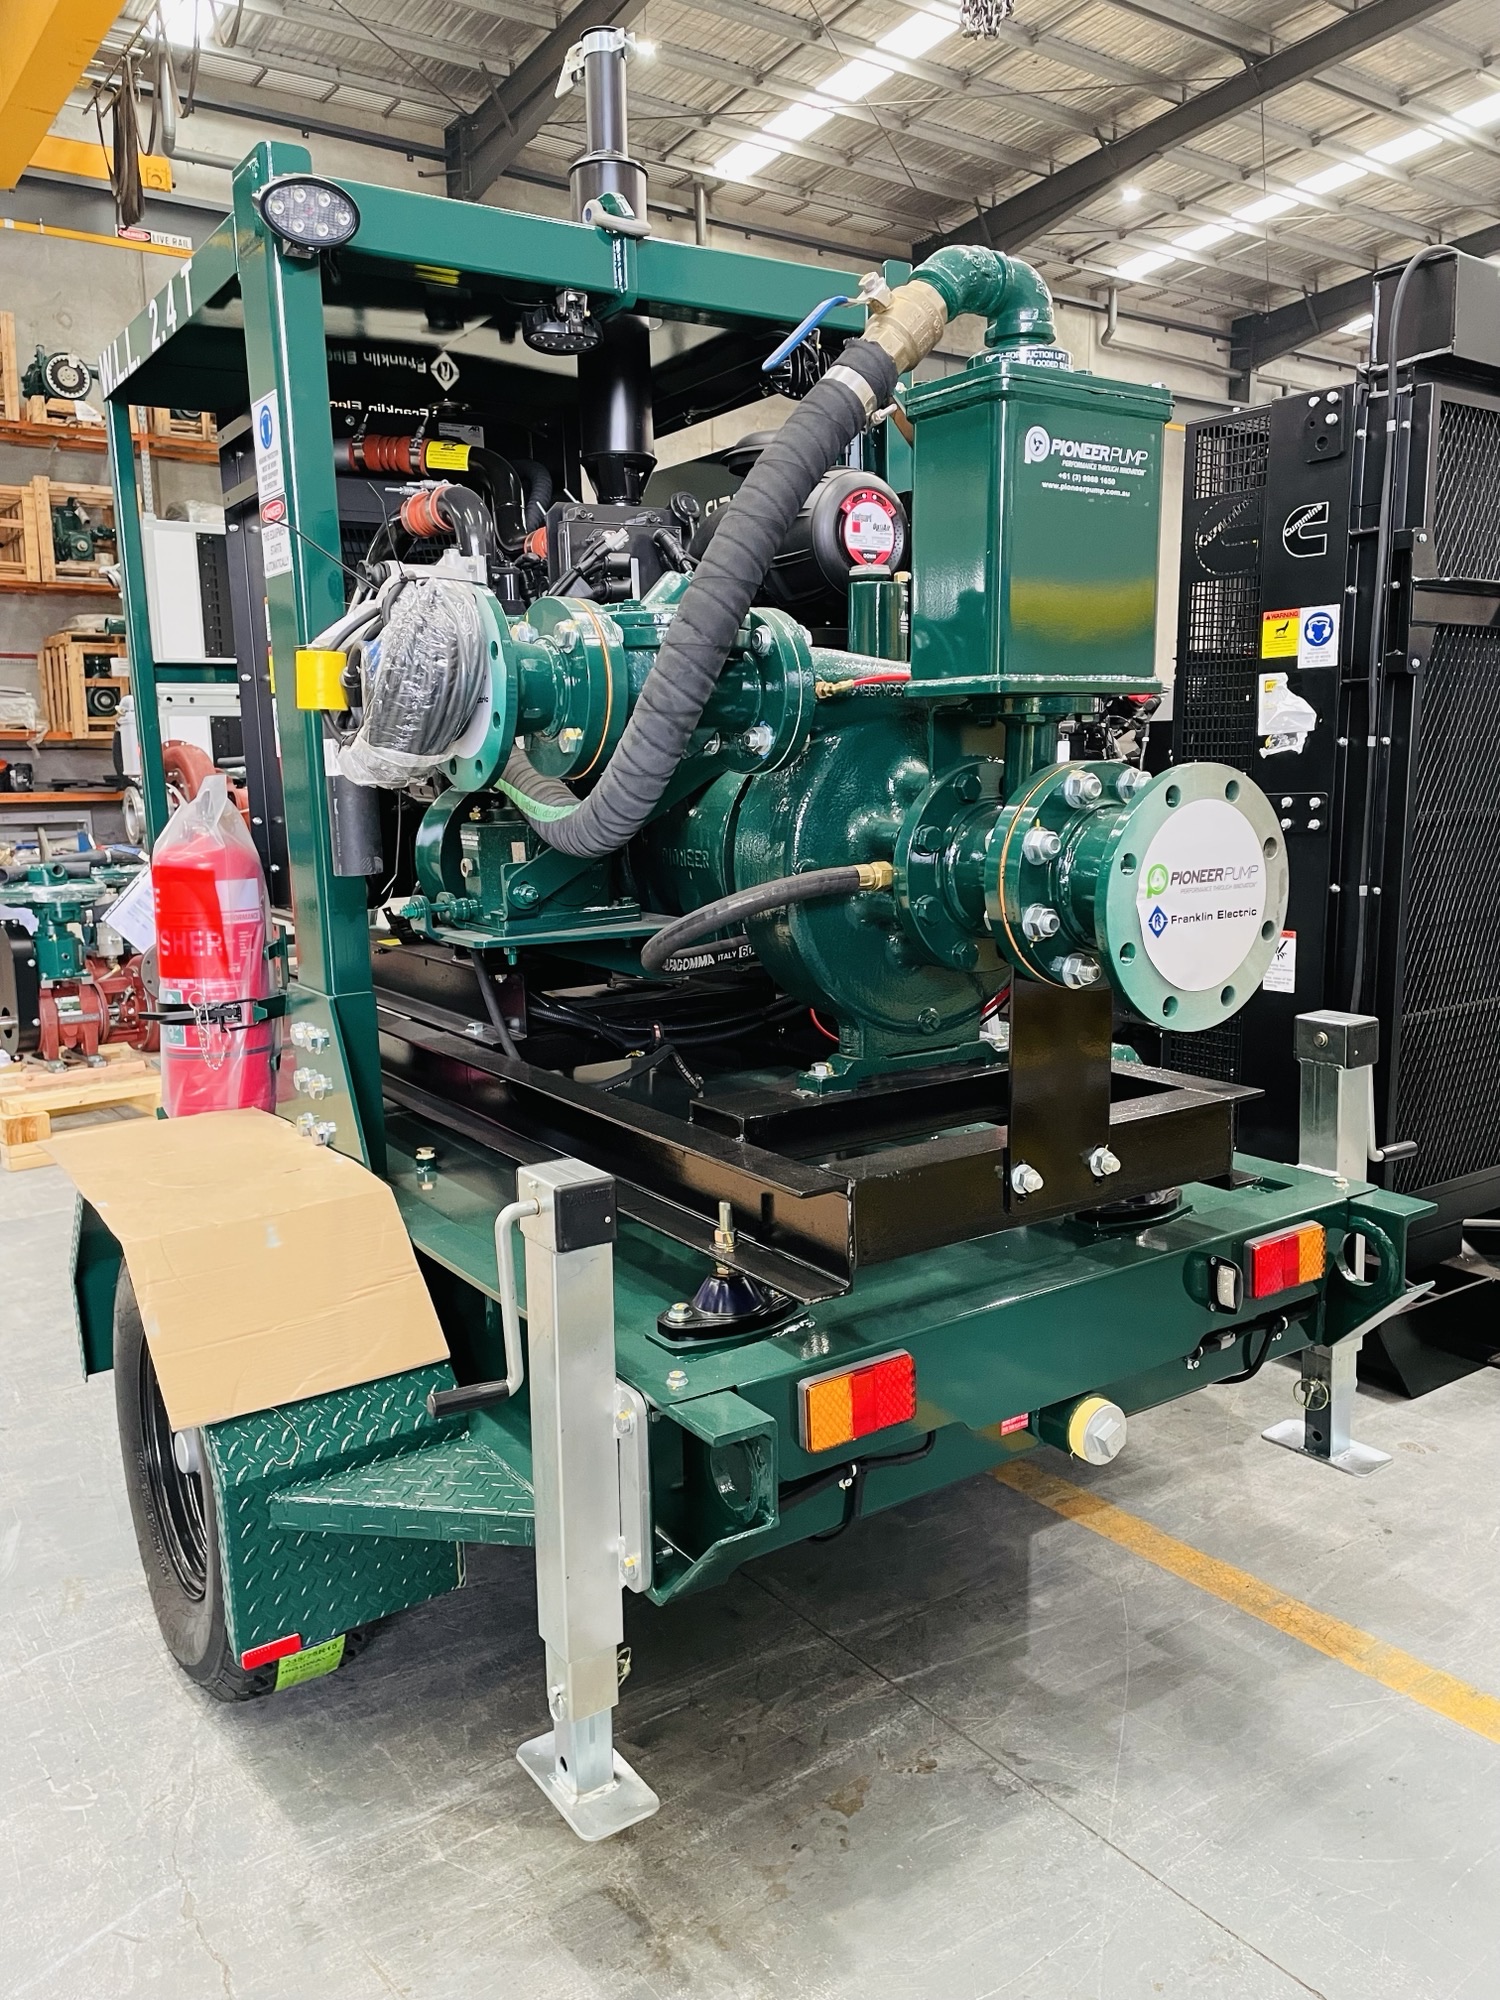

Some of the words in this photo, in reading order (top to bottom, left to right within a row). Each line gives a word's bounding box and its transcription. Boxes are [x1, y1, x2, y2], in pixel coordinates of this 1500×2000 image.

[152, 233, 169, 245] LIVE
[172, 237, 189, 248] RAIL
[149, 278, 177, 353] 2.4
[180, 258, 193, 318] T
[1284, 504, 1323, 538] Cummins
[1270, 610, 1299, 620] WARNING
[1170, 911, 1214, 925] Franklin
[1217, 907, 1258, 920] Electric
[717, 950, 737, 962] ITALY
